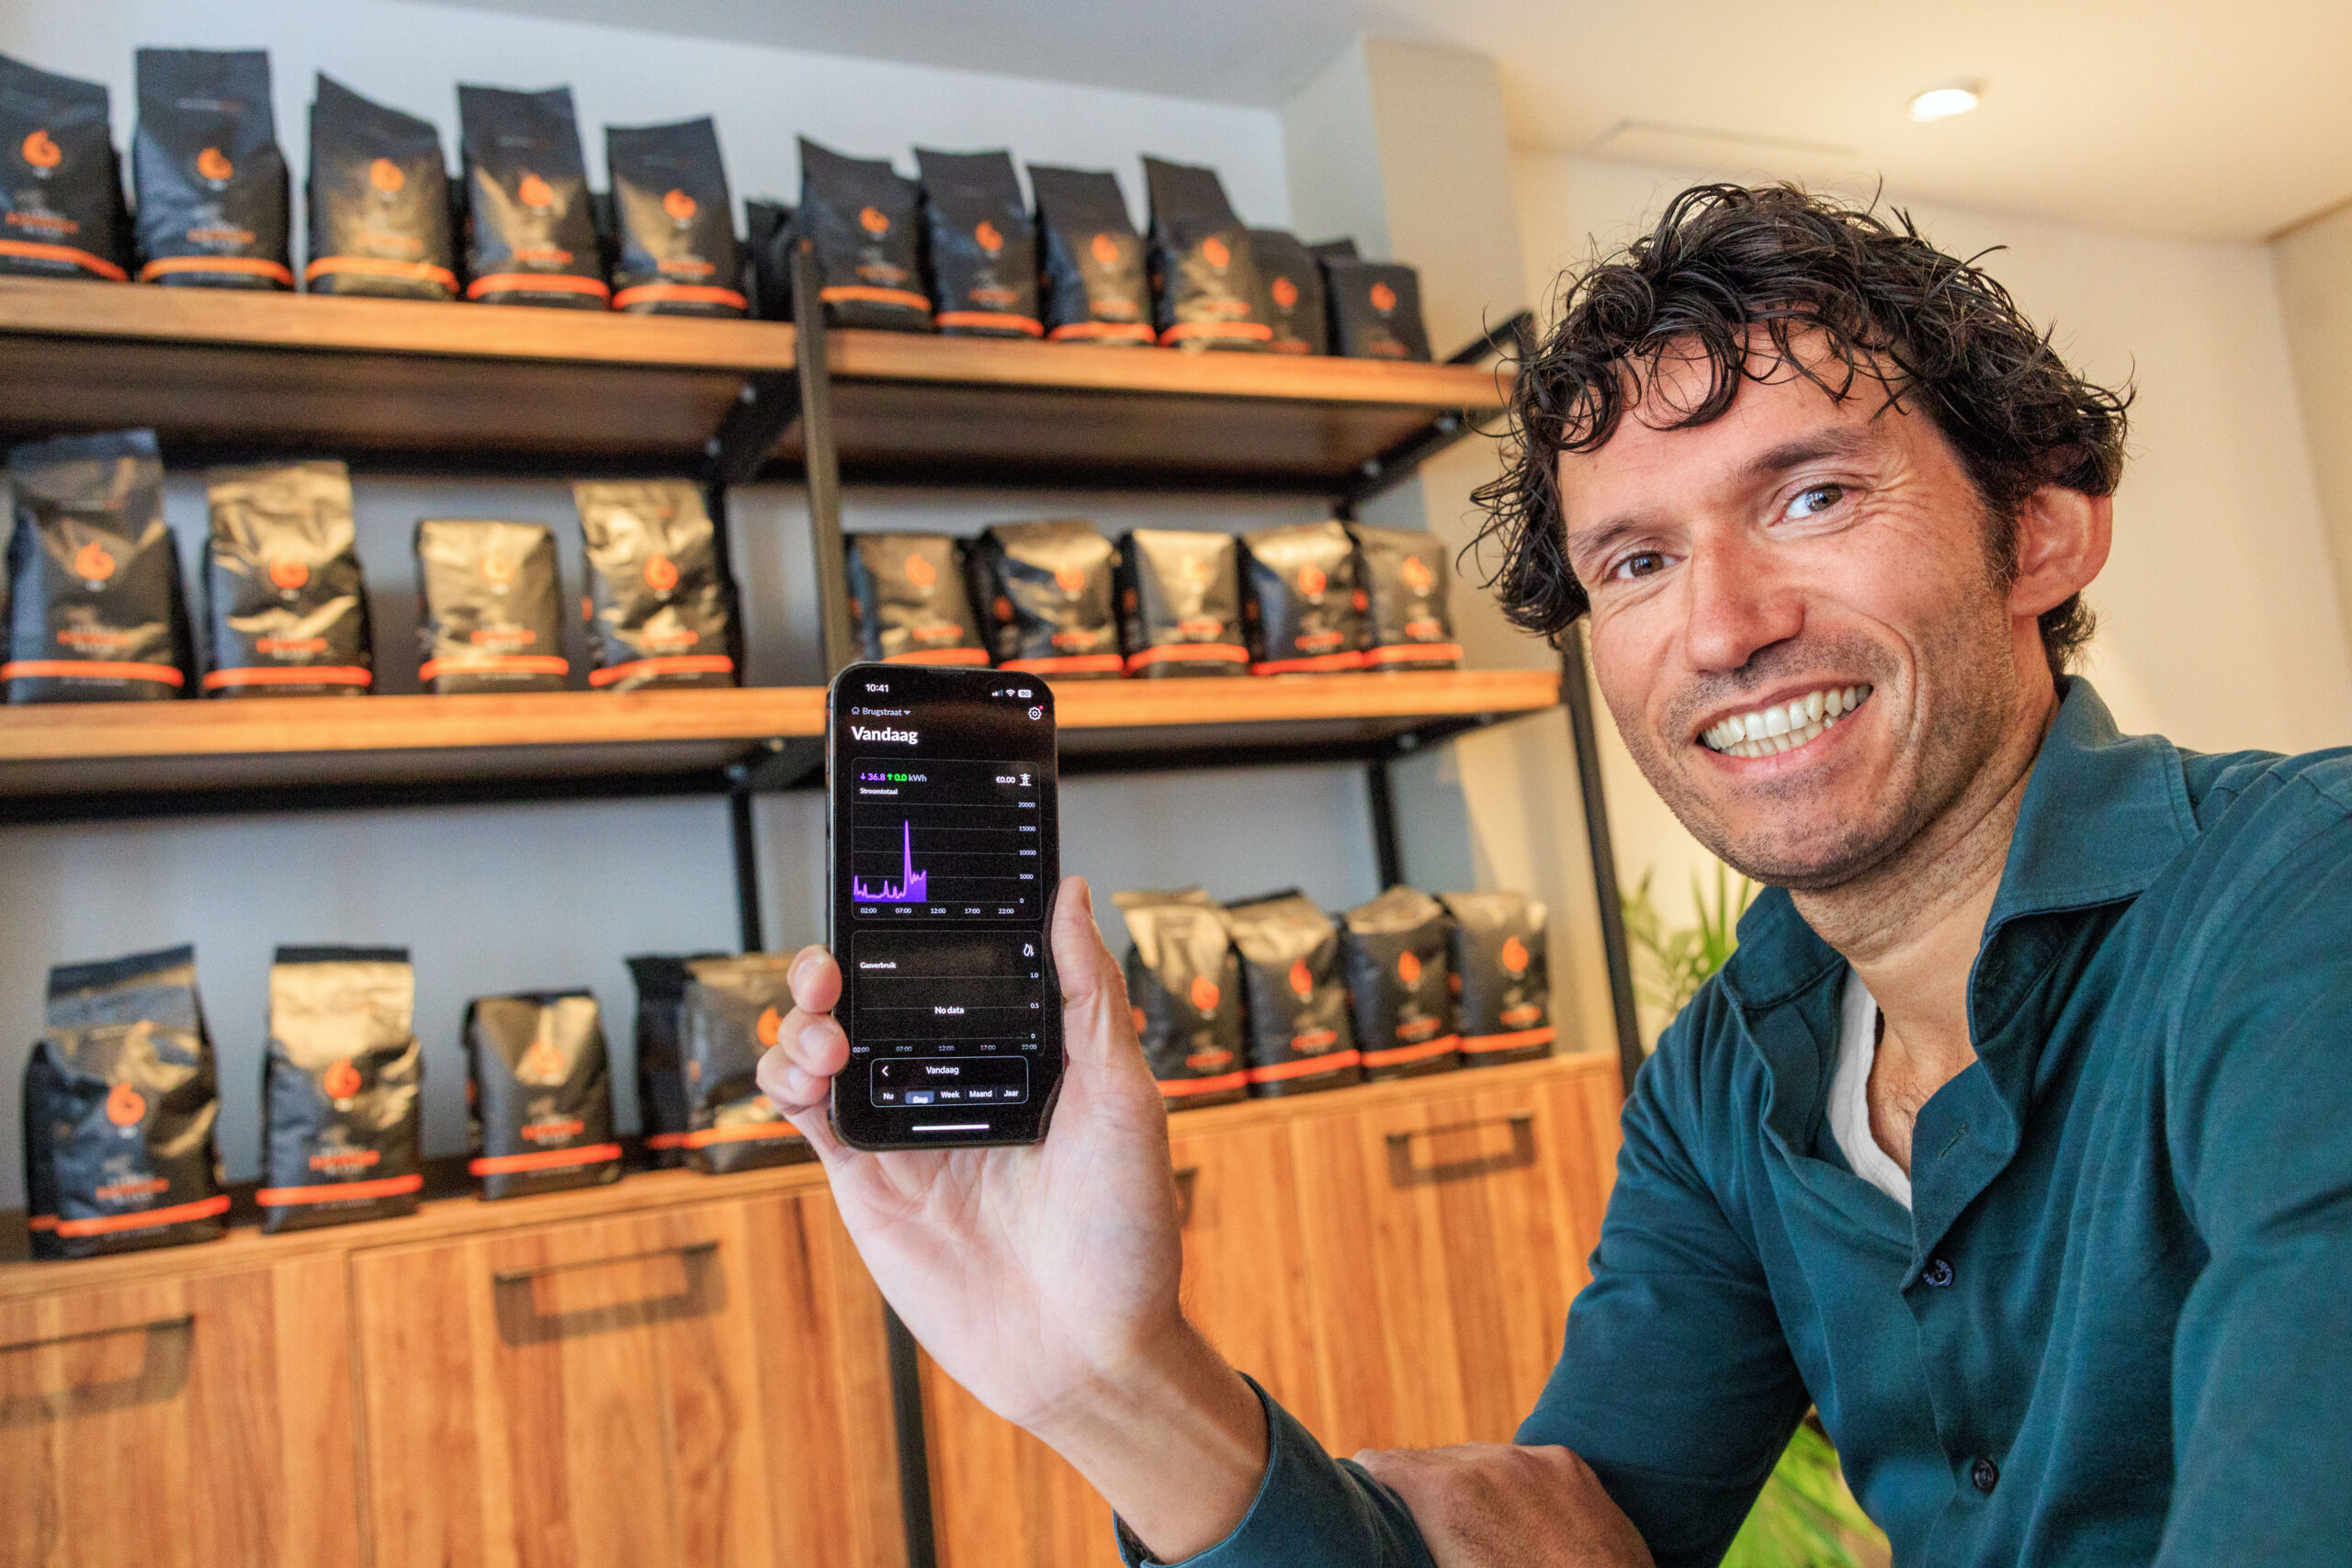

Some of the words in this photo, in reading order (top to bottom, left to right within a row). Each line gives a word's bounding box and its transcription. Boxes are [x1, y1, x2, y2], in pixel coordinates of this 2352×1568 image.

[866, 684, 889, 693] 10:41
[862, 707, 902, 716] Brugstraat
[851, 726, 918, 744] Vandaag
[868, 773, 886, 781] 36.8
[935, 1006, 946, 1015] No
[926, 1066, 959, 1075] Vandaag
